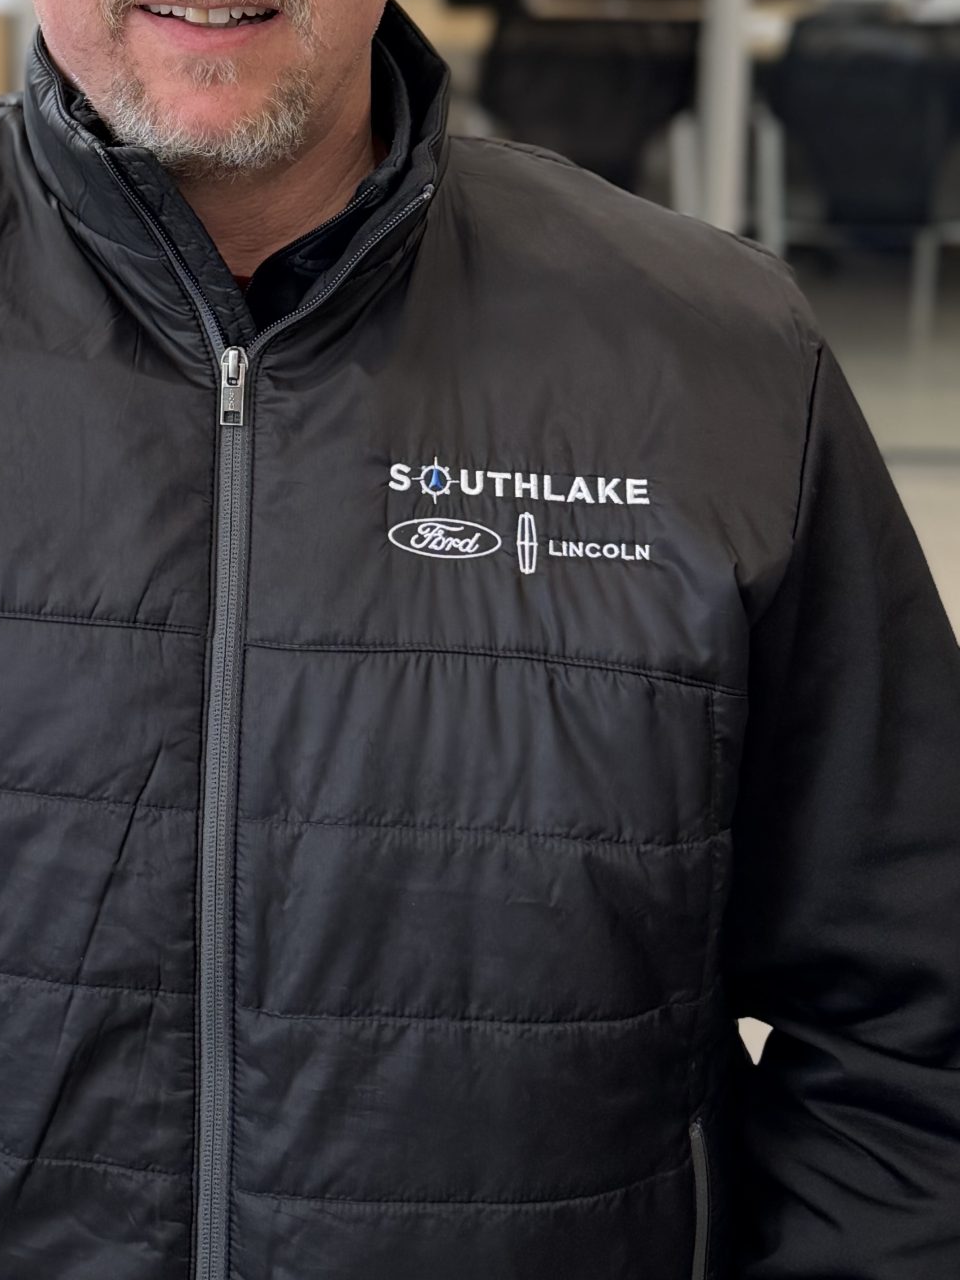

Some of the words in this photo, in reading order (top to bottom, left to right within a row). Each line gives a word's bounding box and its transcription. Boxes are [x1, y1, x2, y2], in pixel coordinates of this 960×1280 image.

[388, 458, 651, 506] SOUTHLAKE
[410, 522, 481, 554] Ford
[548, 539, 650, 560] LINCOLN
